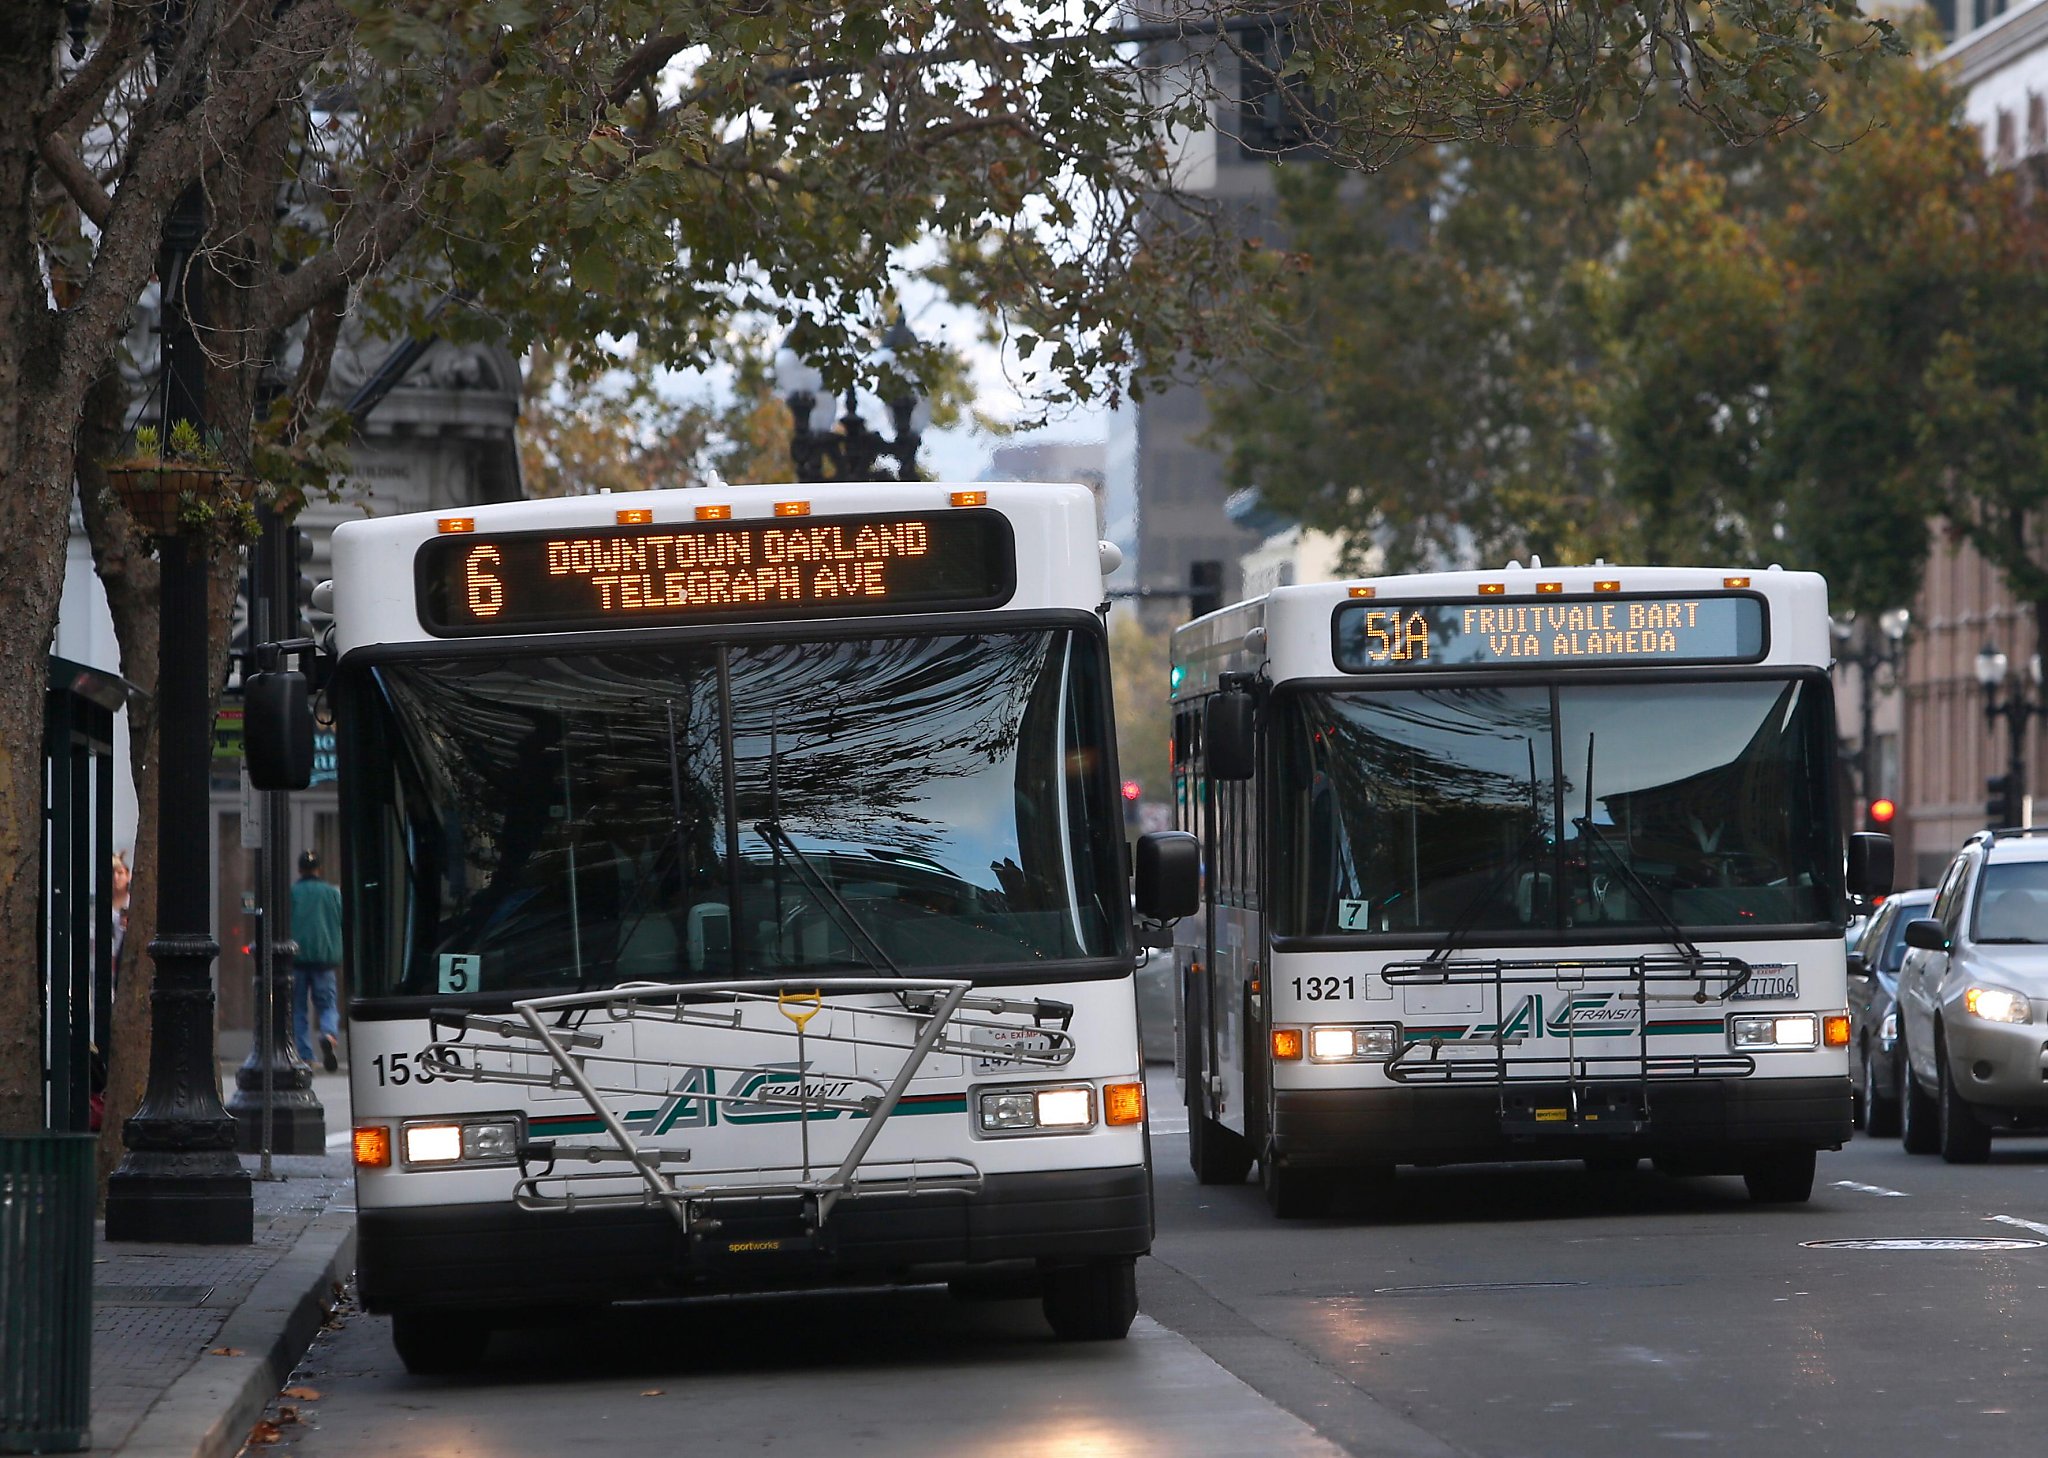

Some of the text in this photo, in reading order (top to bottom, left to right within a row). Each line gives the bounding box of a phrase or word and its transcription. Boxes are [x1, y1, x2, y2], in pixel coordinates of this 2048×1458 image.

[344, 464, 410, 480] UILDING
[548, 522, 927, 575] DOWNTOWN OAKLAND
[466, 545, 503, 616] 6
[592, 561, 886, 608] TELEGRAPH AVE
[1463, 602, 1700, 634] FRUITVALE BART
[1366, 610, 1429, 661] 51A
[1489, 630, 1677, 657] VIA ALAMEDA
[1346, 903, 1361, 926] 7
[448, 957, 468, 992] 5
[1291, 976, 1354, 1001] 1321
[1572, 1008, 1640, 1021] TRANSIT
[728, 1241, 779, 1253] sportworks
